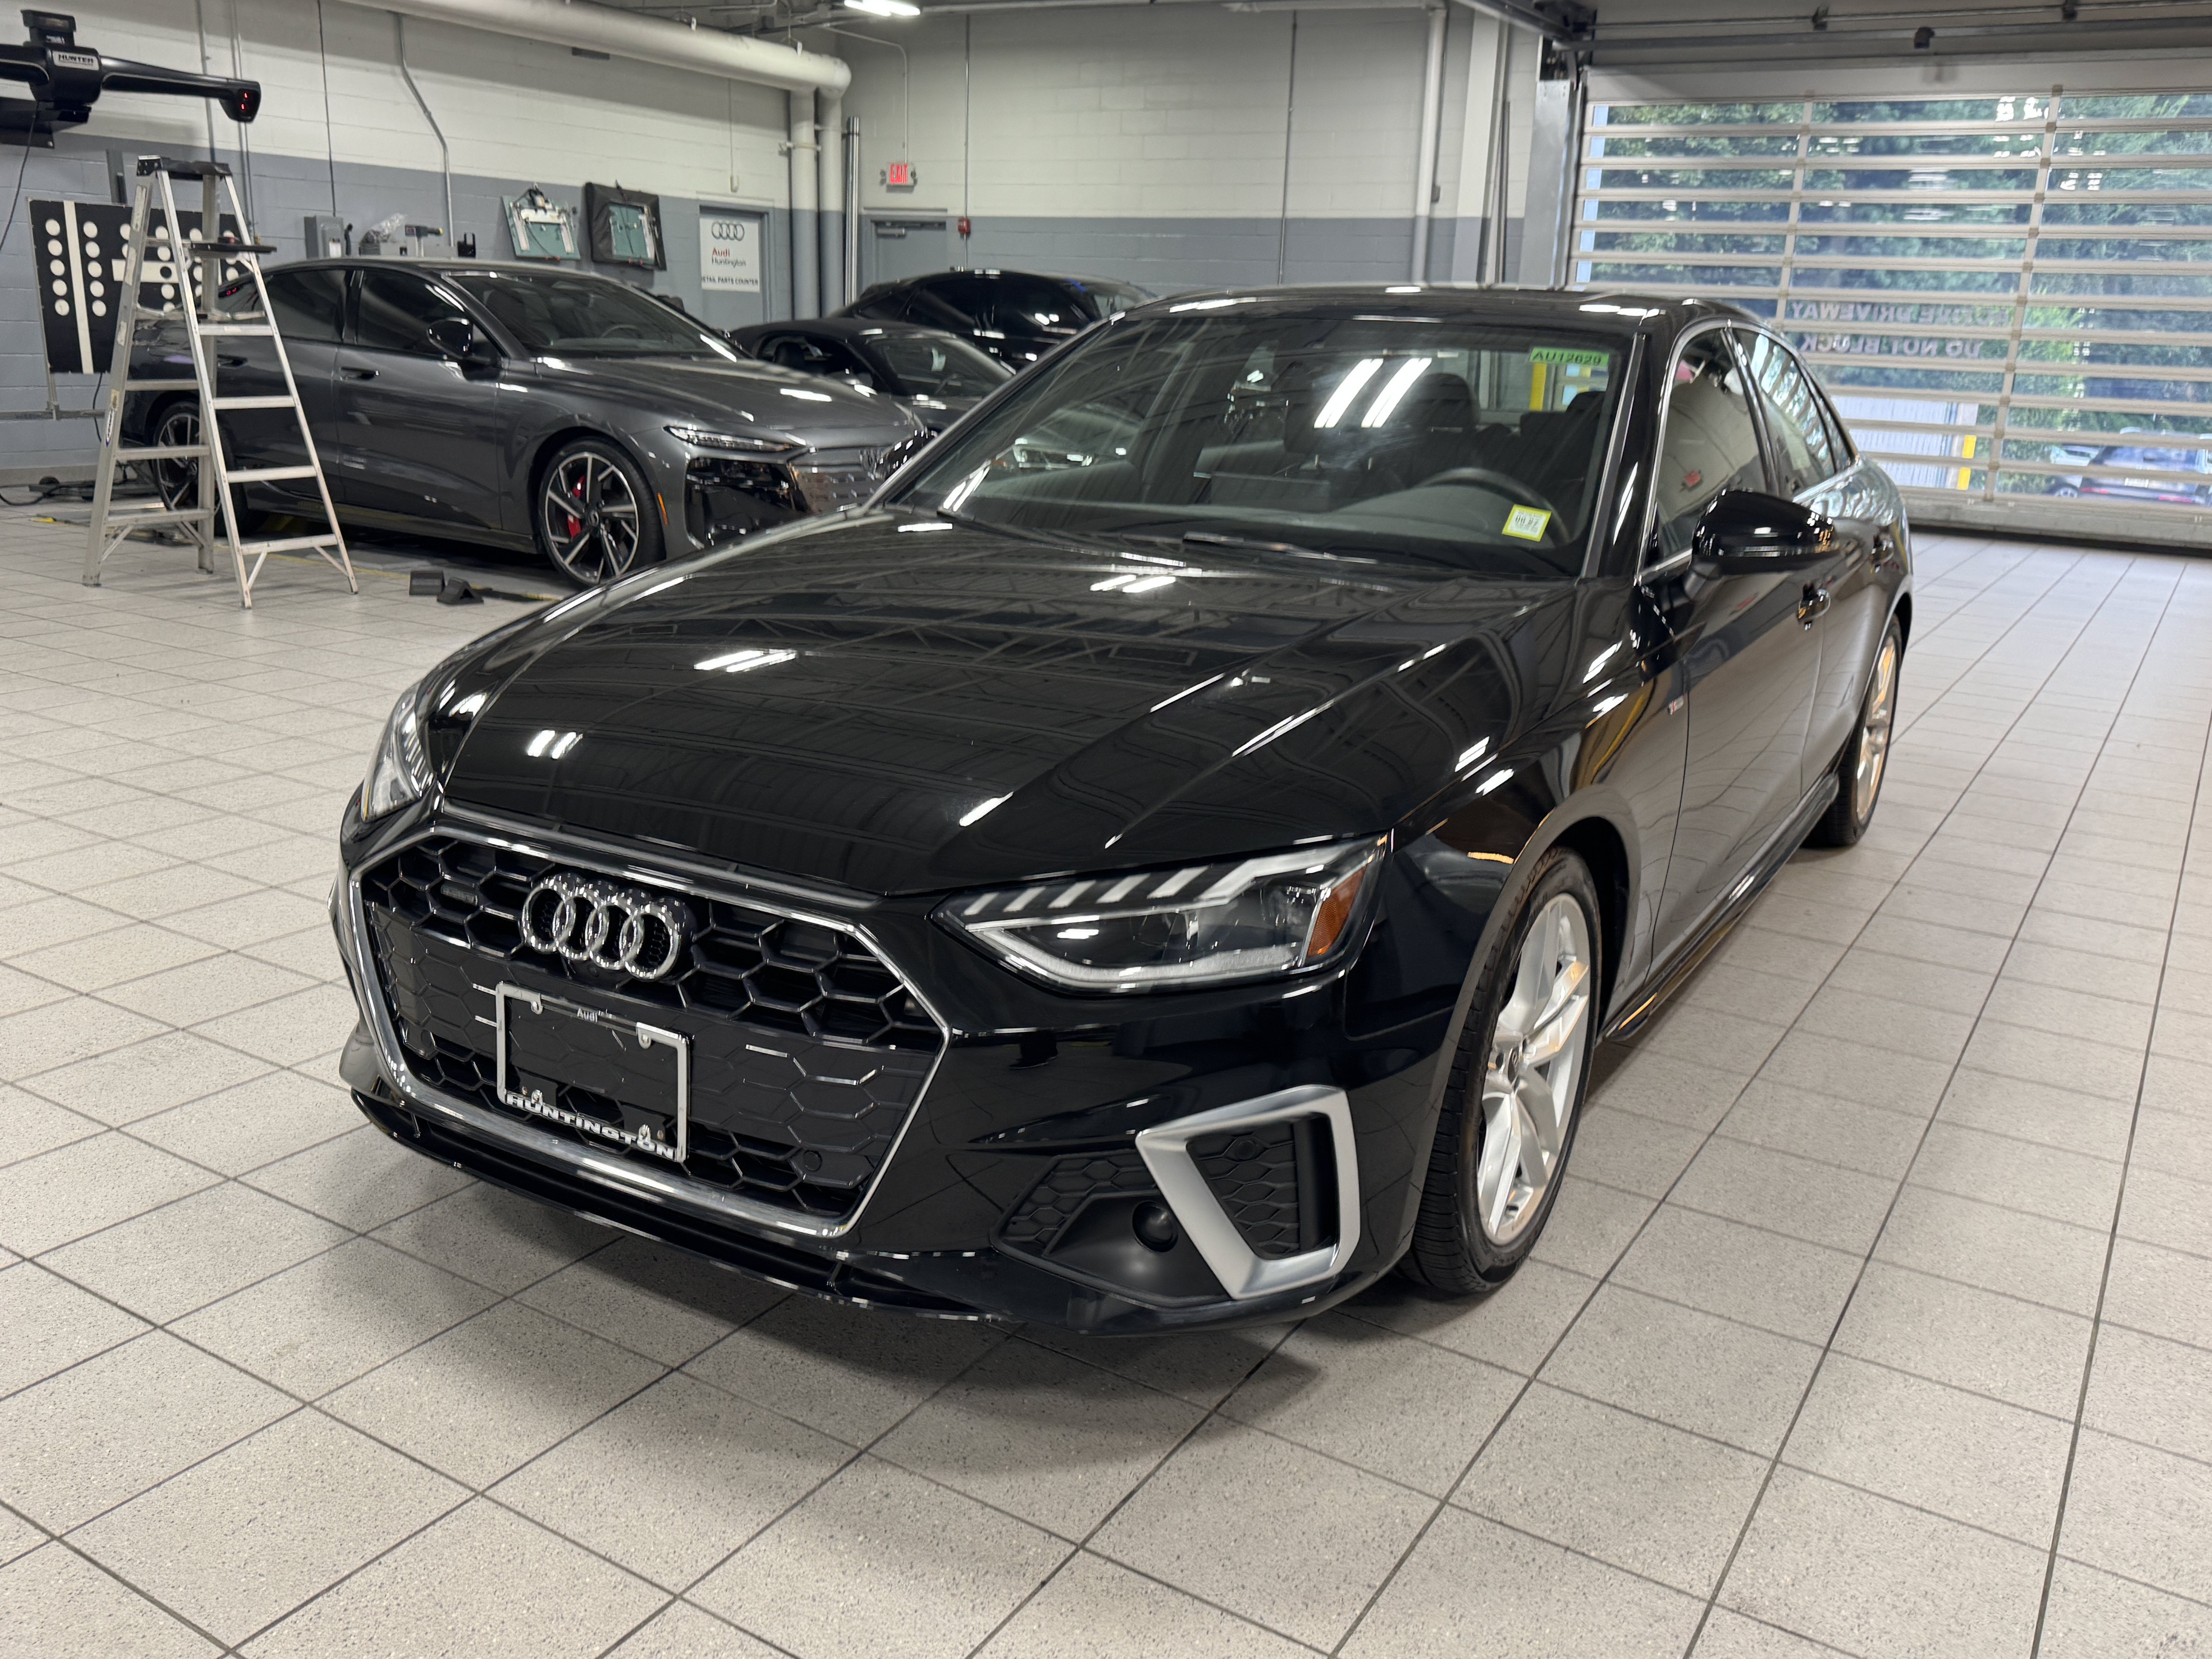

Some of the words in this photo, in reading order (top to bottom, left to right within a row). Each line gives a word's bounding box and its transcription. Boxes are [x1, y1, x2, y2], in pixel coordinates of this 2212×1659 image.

[59, 54, 93, 63] HUNTER
[713, 247, 730, 257] Audi
[712, 257, 746, 268] Huntington
[577, 1008, 597, 1023] Audi
[507, 1093, 676, 1160] HUNTINGTON
